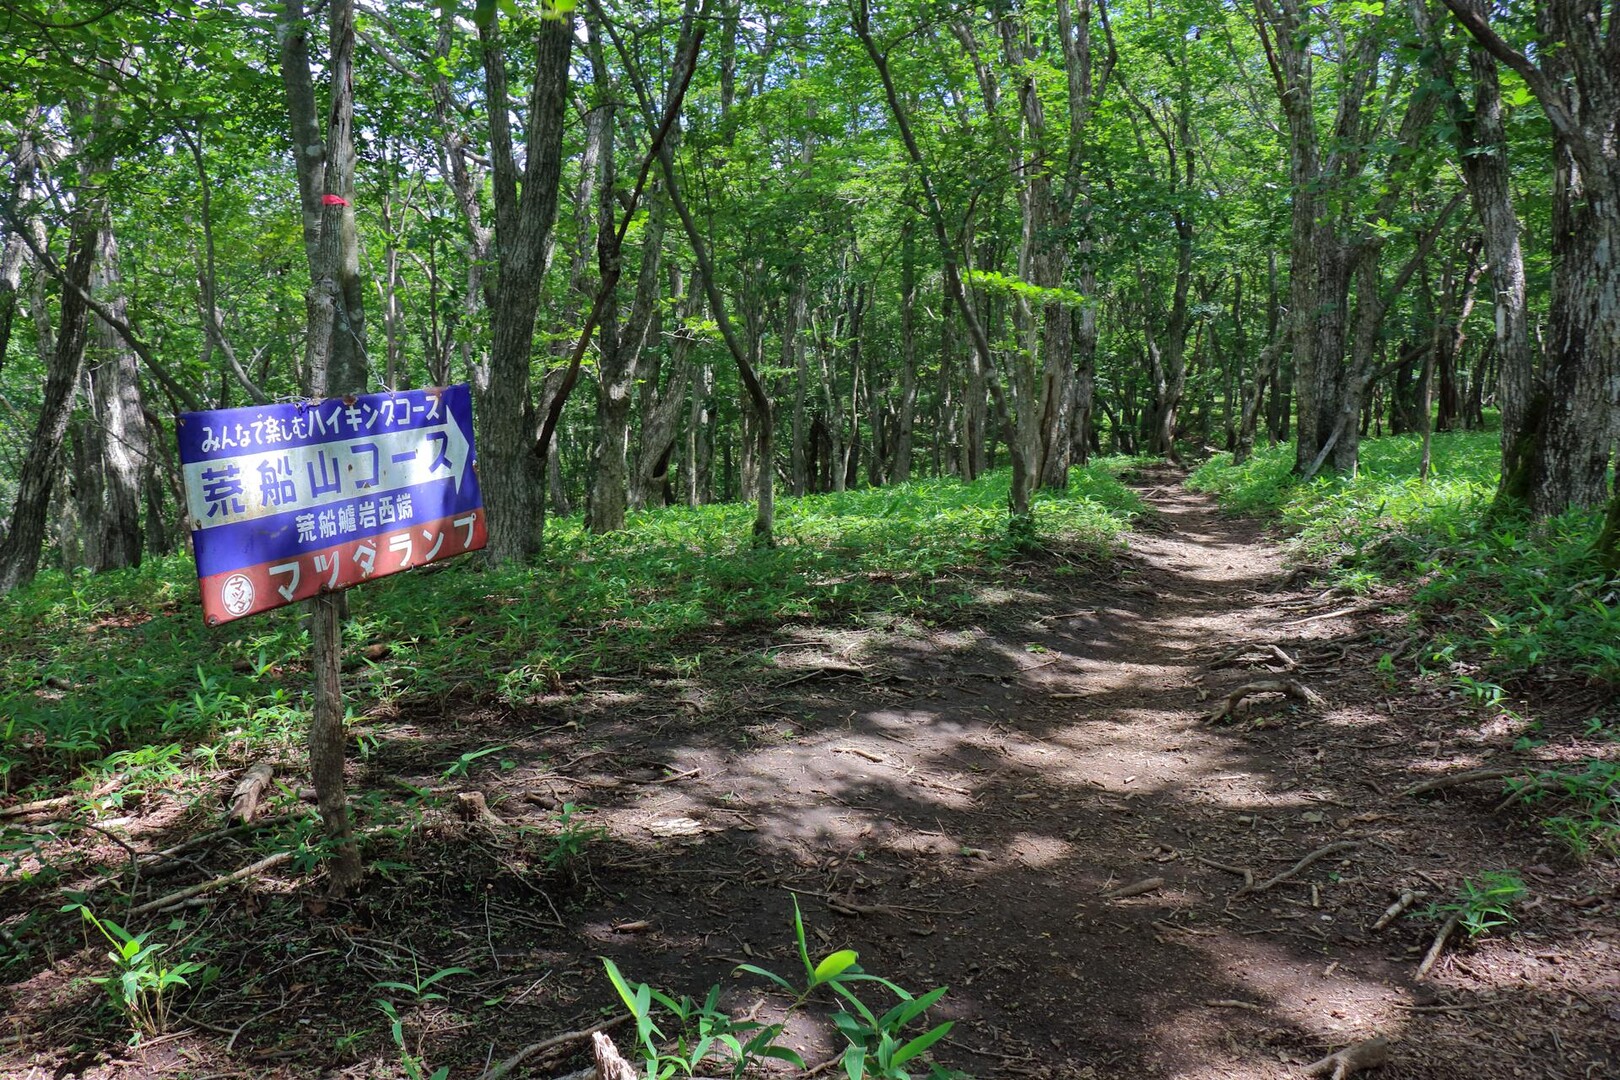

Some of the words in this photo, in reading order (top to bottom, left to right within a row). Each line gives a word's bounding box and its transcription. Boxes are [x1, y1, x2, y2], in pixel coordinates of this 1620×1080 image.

[202, 396, 439, 453] みんなで楽しむハイキングコース
[201, 429, 453, 518] 荒船山コース
[269, 512, 477, 602] マツダランプ
